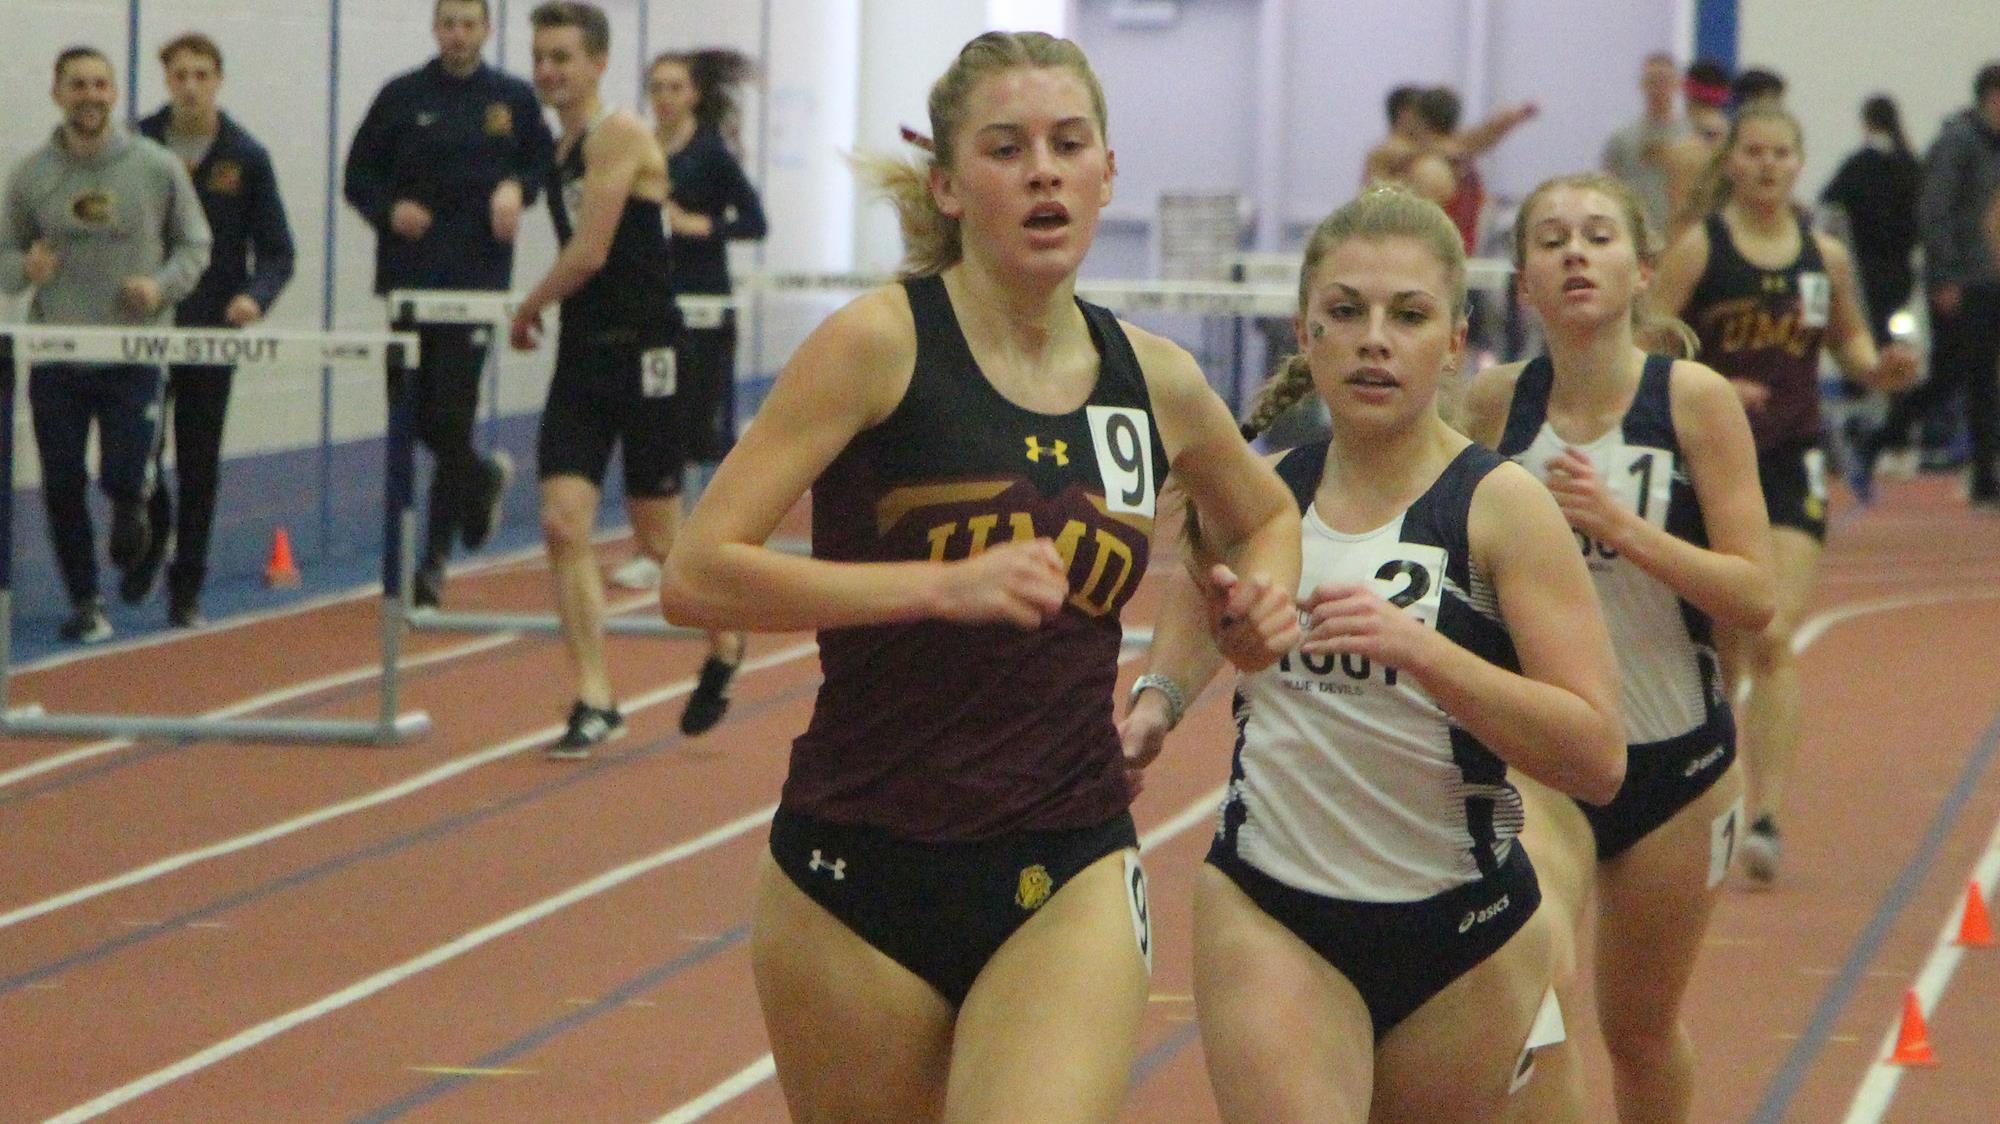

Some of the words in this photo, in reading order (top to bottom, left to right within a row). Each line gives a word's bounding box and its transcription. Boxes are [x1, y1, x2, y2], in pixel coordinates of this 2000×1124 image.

[1105, 412, 1146, 507] 9
[1628, 453, 1653, 520] 1
[1374, 559, 1431, 610] 2
[1722, 810, 1736, 872] 1
[1132, 866, 1148, 955] 9
[1476, 894, 1510, 924] asics
